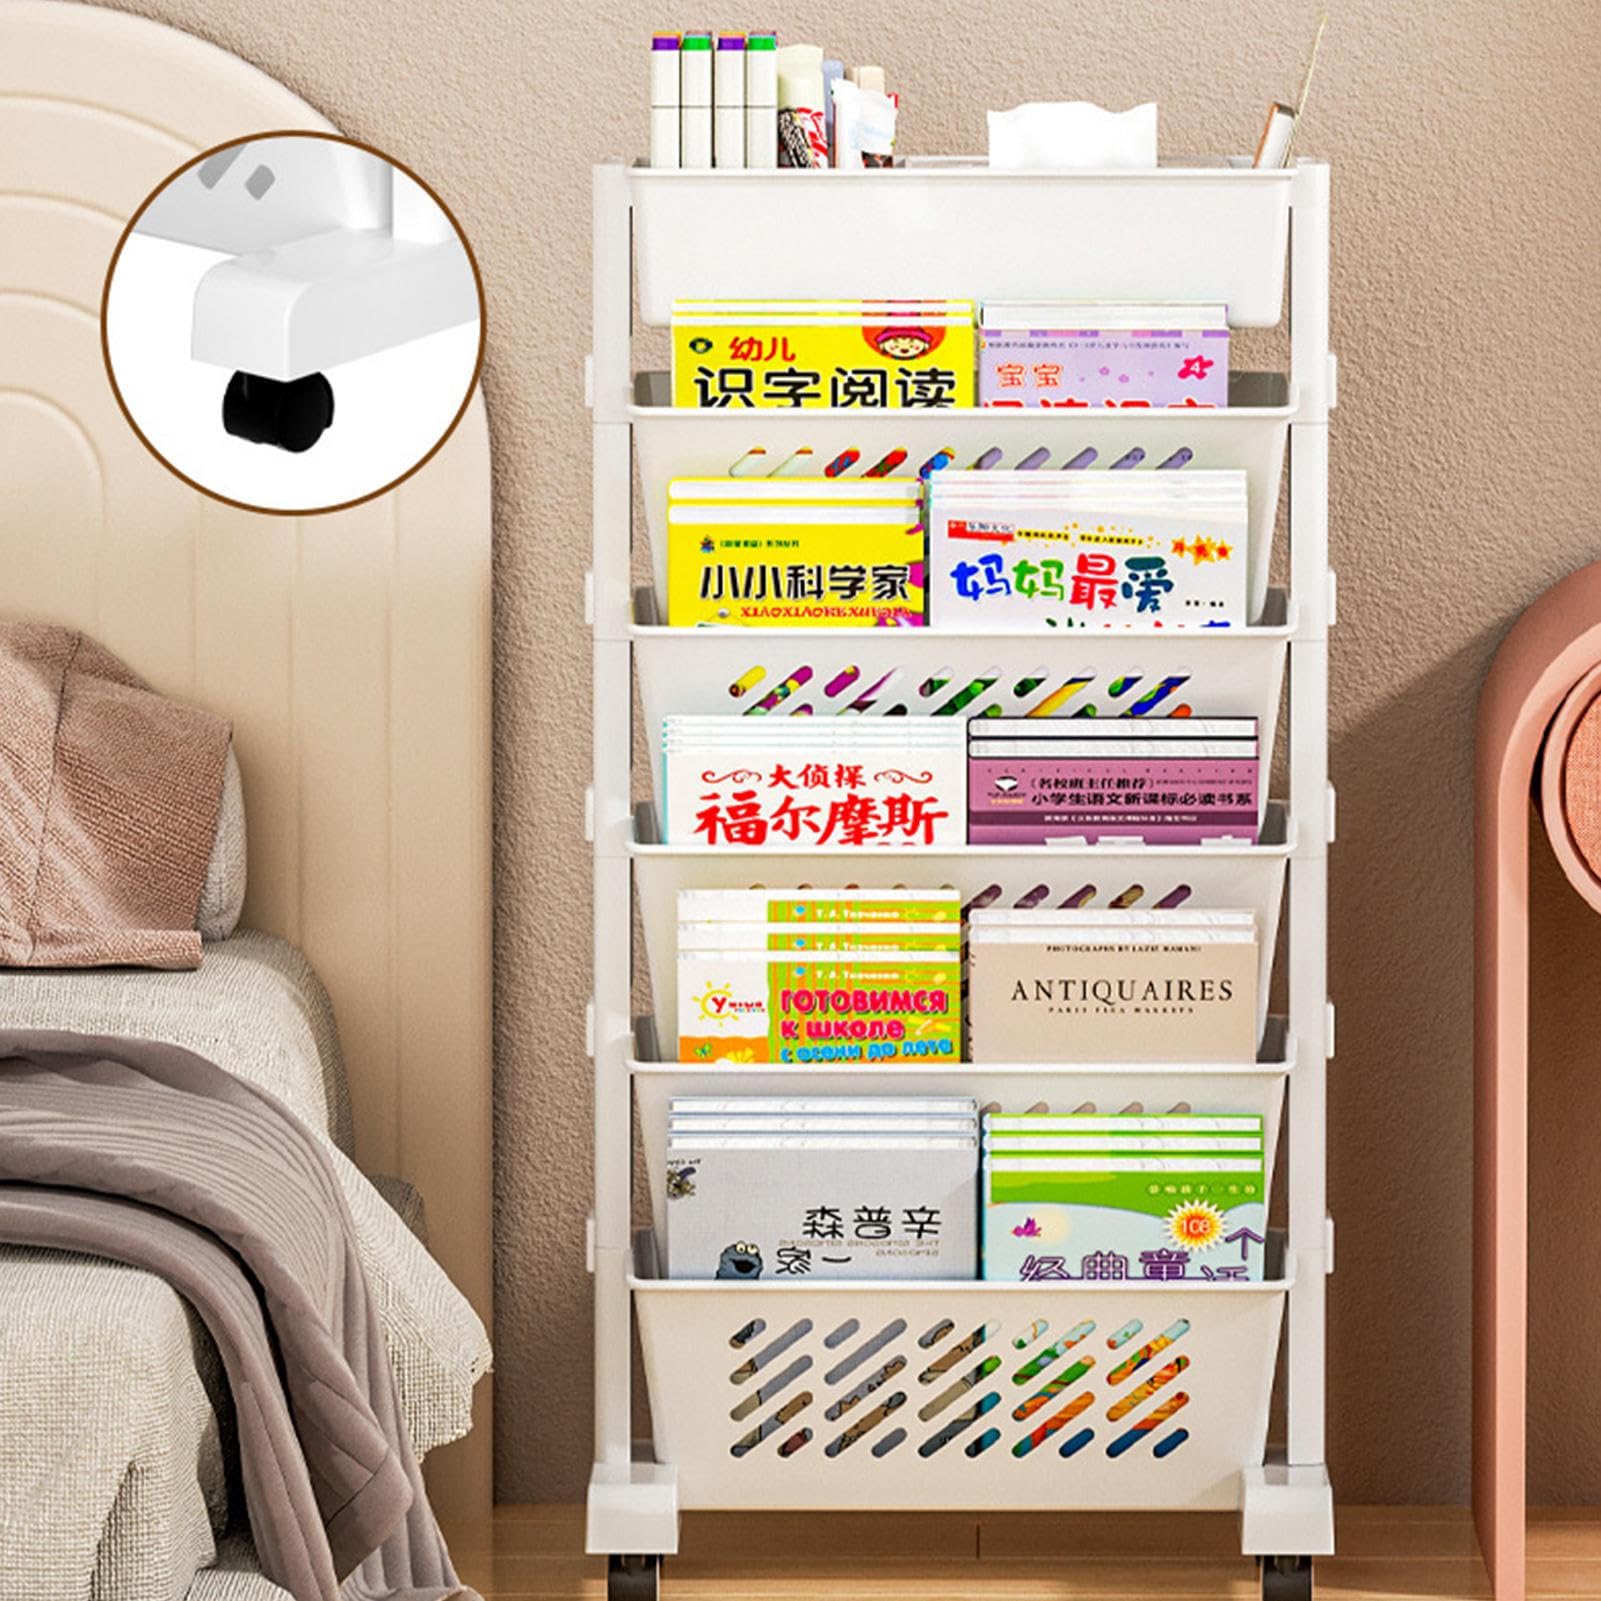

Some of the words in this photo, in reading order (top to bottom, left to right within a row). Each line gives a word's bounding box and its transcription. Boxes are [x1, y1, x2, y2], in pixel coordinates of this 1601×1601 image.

[729, 336, 796, 361] 幼儿
[694, 366, 956, 407] 识字阅读
[996, 363, 1062, 387] 宝宝
[700, 565, 908, 600] 小小科学家
[950, 553, 1174, 613] 妈妈最爱
[767, 763, 867, 790] 大侦探
[1031, 792, 1253, 806] 小学生语文新课标必读书系
[693, 790, 949, 845] 福尔摩斯
[781, 989, 948, 1013] ГОТОВИМСЯ
[1011, 979, 1234, 1005] ANTIQUAIRES
[1180, 1216, 1213, 1235] 108
